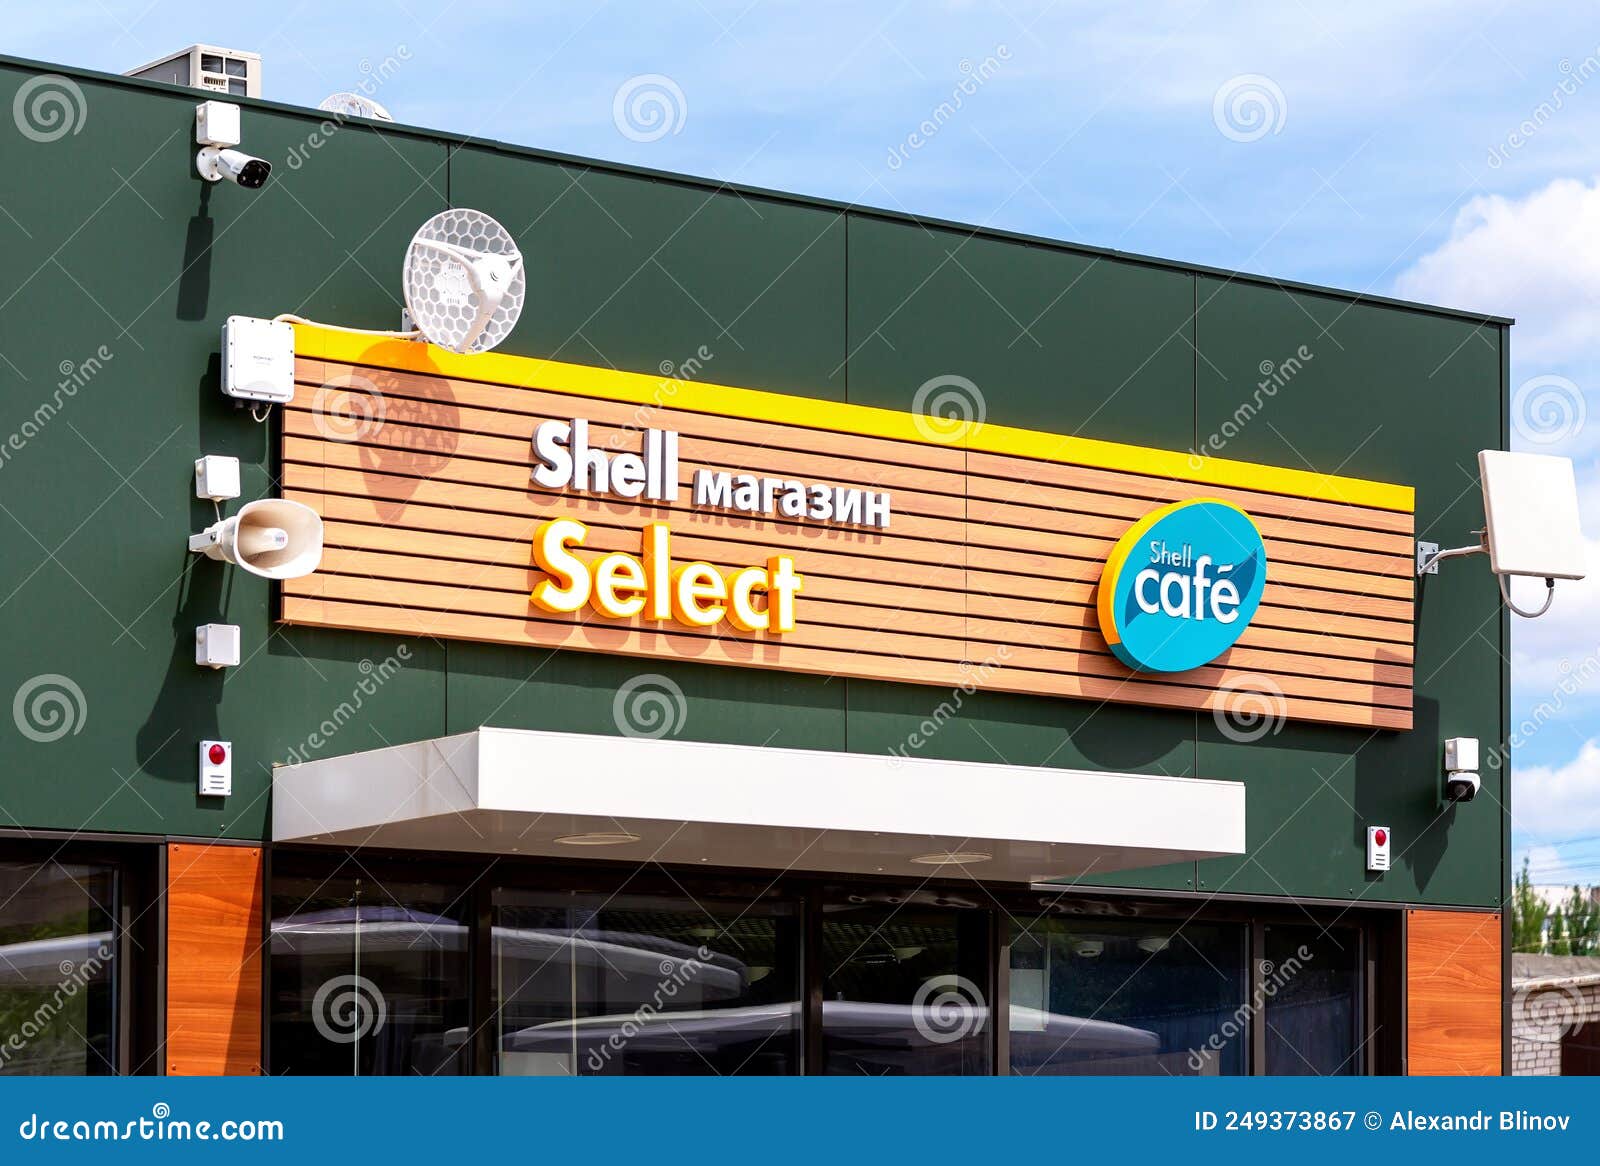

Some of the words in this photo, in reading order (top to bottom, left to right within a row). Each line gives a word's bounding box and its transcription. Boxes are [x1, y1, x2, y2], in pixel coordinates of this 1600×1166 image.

[530, 418, 679, 502] Shell
[693, 468, 891, 529] магазин
[528, 516, 804, 634] Select
[1134, 555, 1241, 625] café
[1150, 540, 1192, 568] Shell
